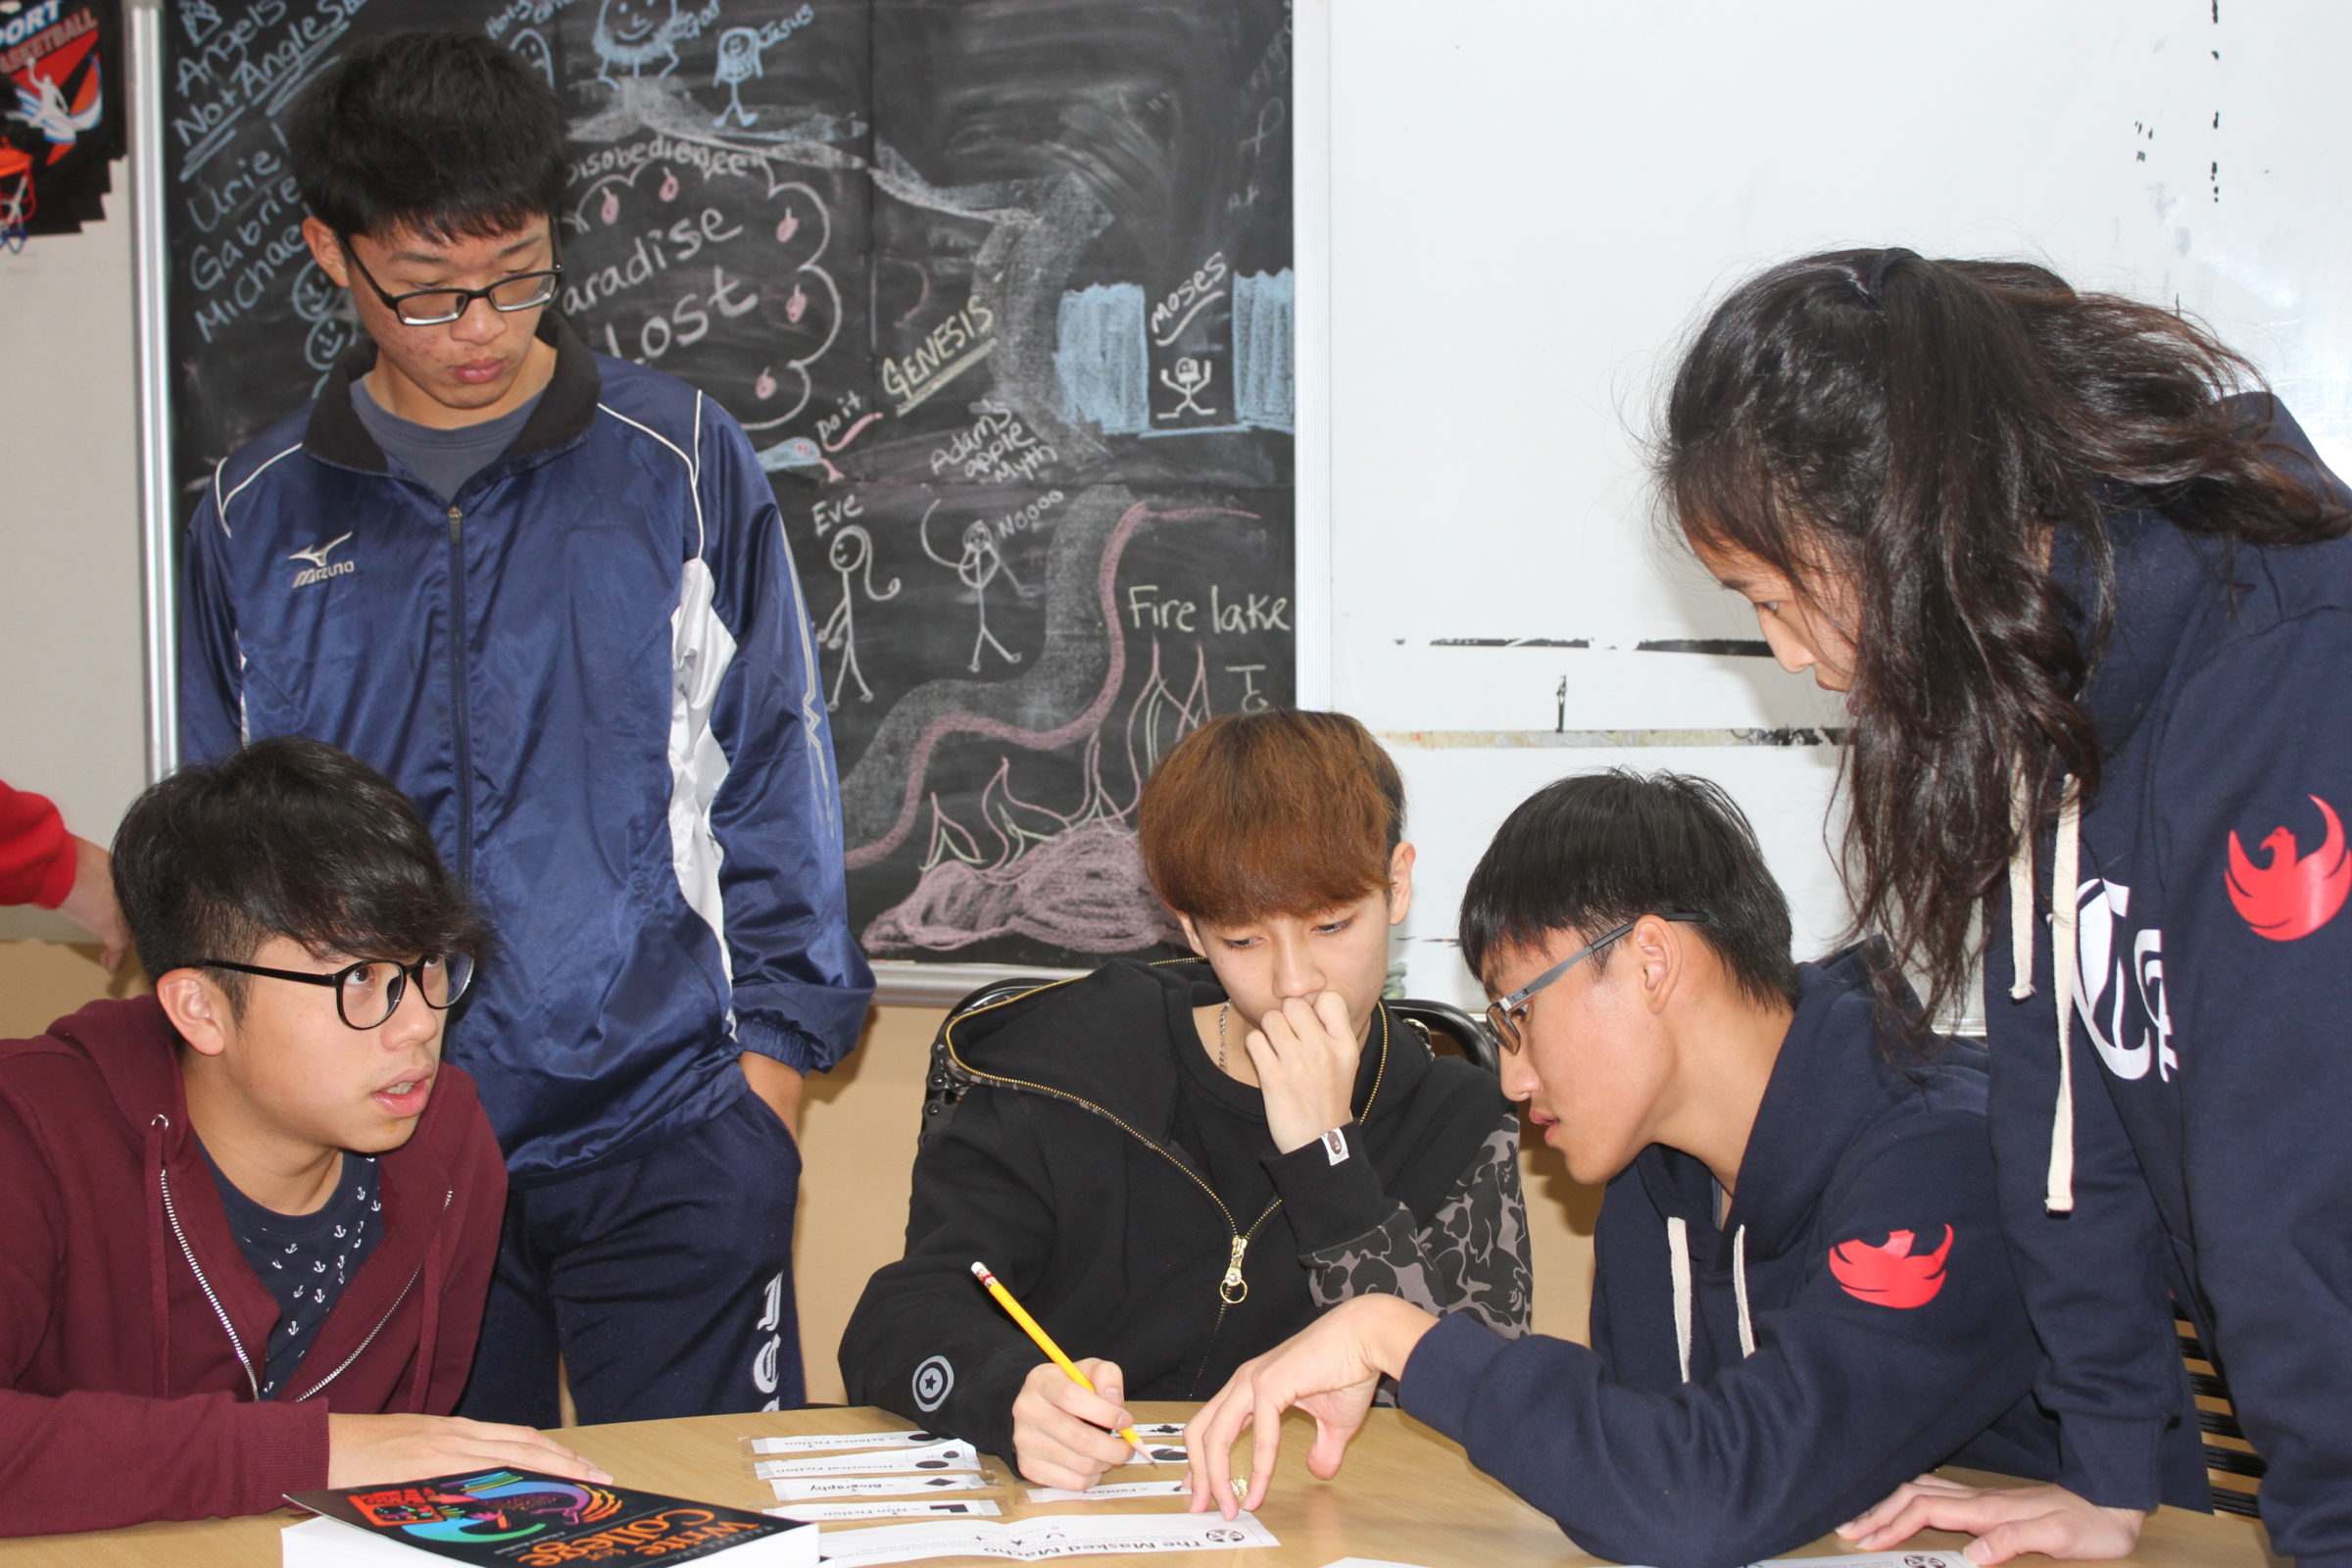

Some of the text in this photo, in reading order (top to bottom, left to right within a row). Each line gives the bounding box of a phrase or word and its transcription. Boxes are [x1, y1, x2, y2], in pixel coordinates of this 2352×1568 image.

[175, 0, 287, 97] Angels
[759, 3, 814, 49] Jesus
[172, 86, 238, 147] Not
[563, 208, 743, 316] aradise
[882, 295, 994, 401] GENESIS
[811, 494, 863, 536] Eve
[1129, 585, 1292, 634] Fire lake
[517, 1508, 715, 1566] College
[635, 1520, 760, 1556] Write
[1067, 1543, 1156, 1552] Masked
[1162, 1540, 1205, 1548] The
